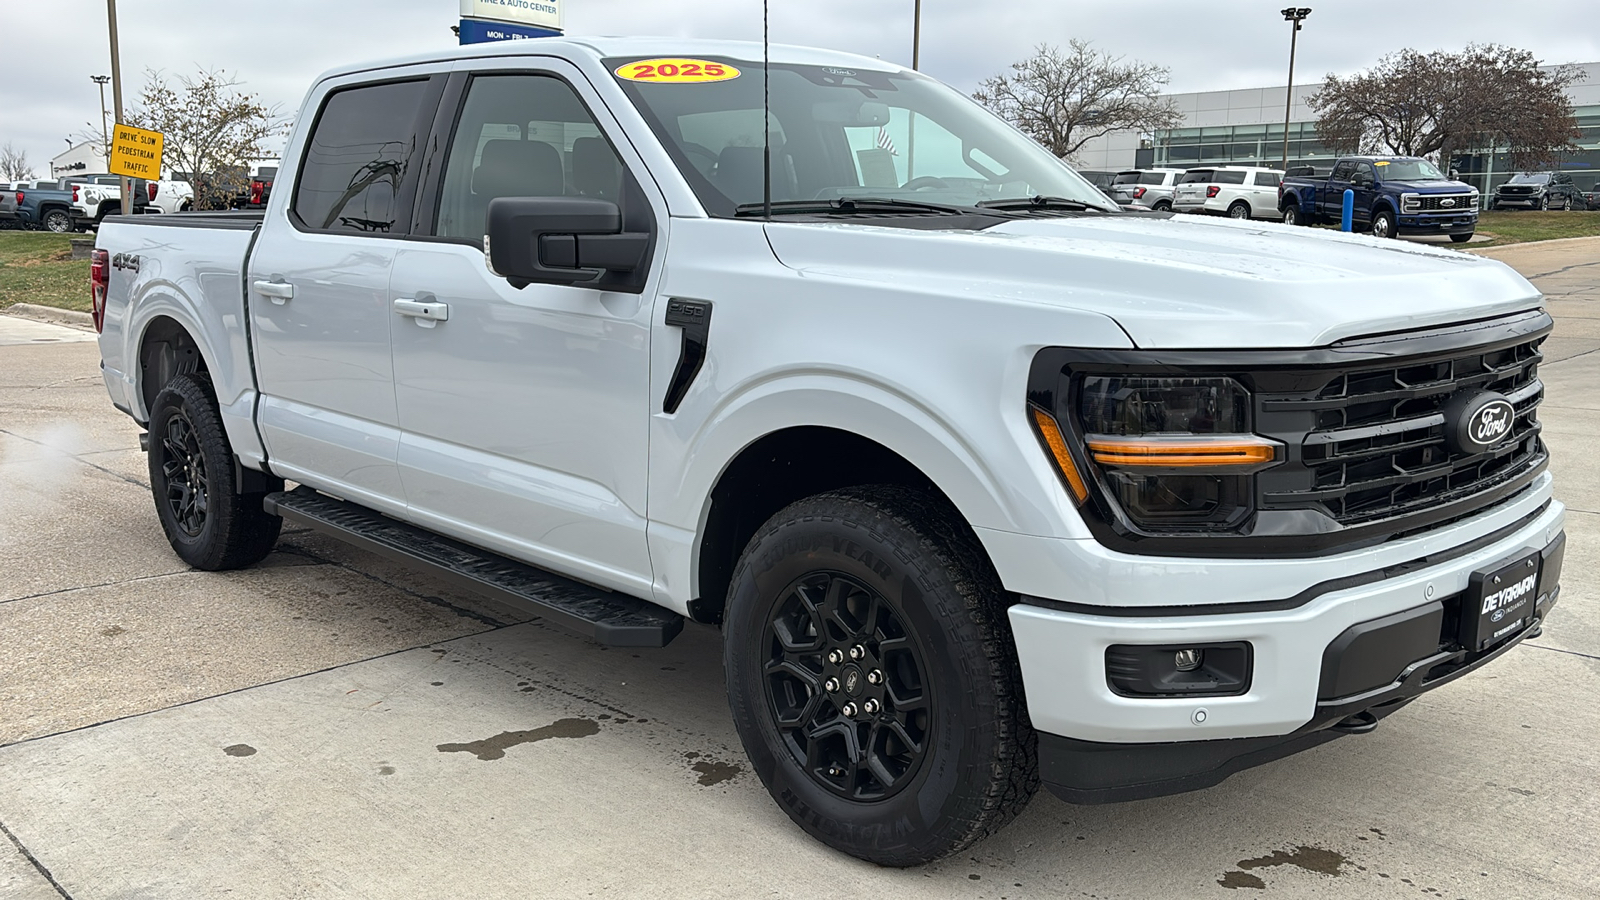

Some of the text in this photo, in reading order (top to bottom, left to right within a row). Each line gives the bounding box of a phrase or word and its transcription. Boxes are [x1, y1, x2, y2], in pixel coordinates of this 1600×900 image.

[507, 0, 529, 9] AUTO
[530, 2, 557, 15] CENTER
[487, 31, 504, 39] MON
[633, 64, 726, 78] 2025
[120, 131, 157, 146] DRIVE SLOW
[118, 145, 155, 160] PEDESTRIAN
[124, 161, 149, 173] TRAFFIC
[1477, 406, 1508, 439] Ford
[1481, 572, 1537, 615] DEYARMAN
